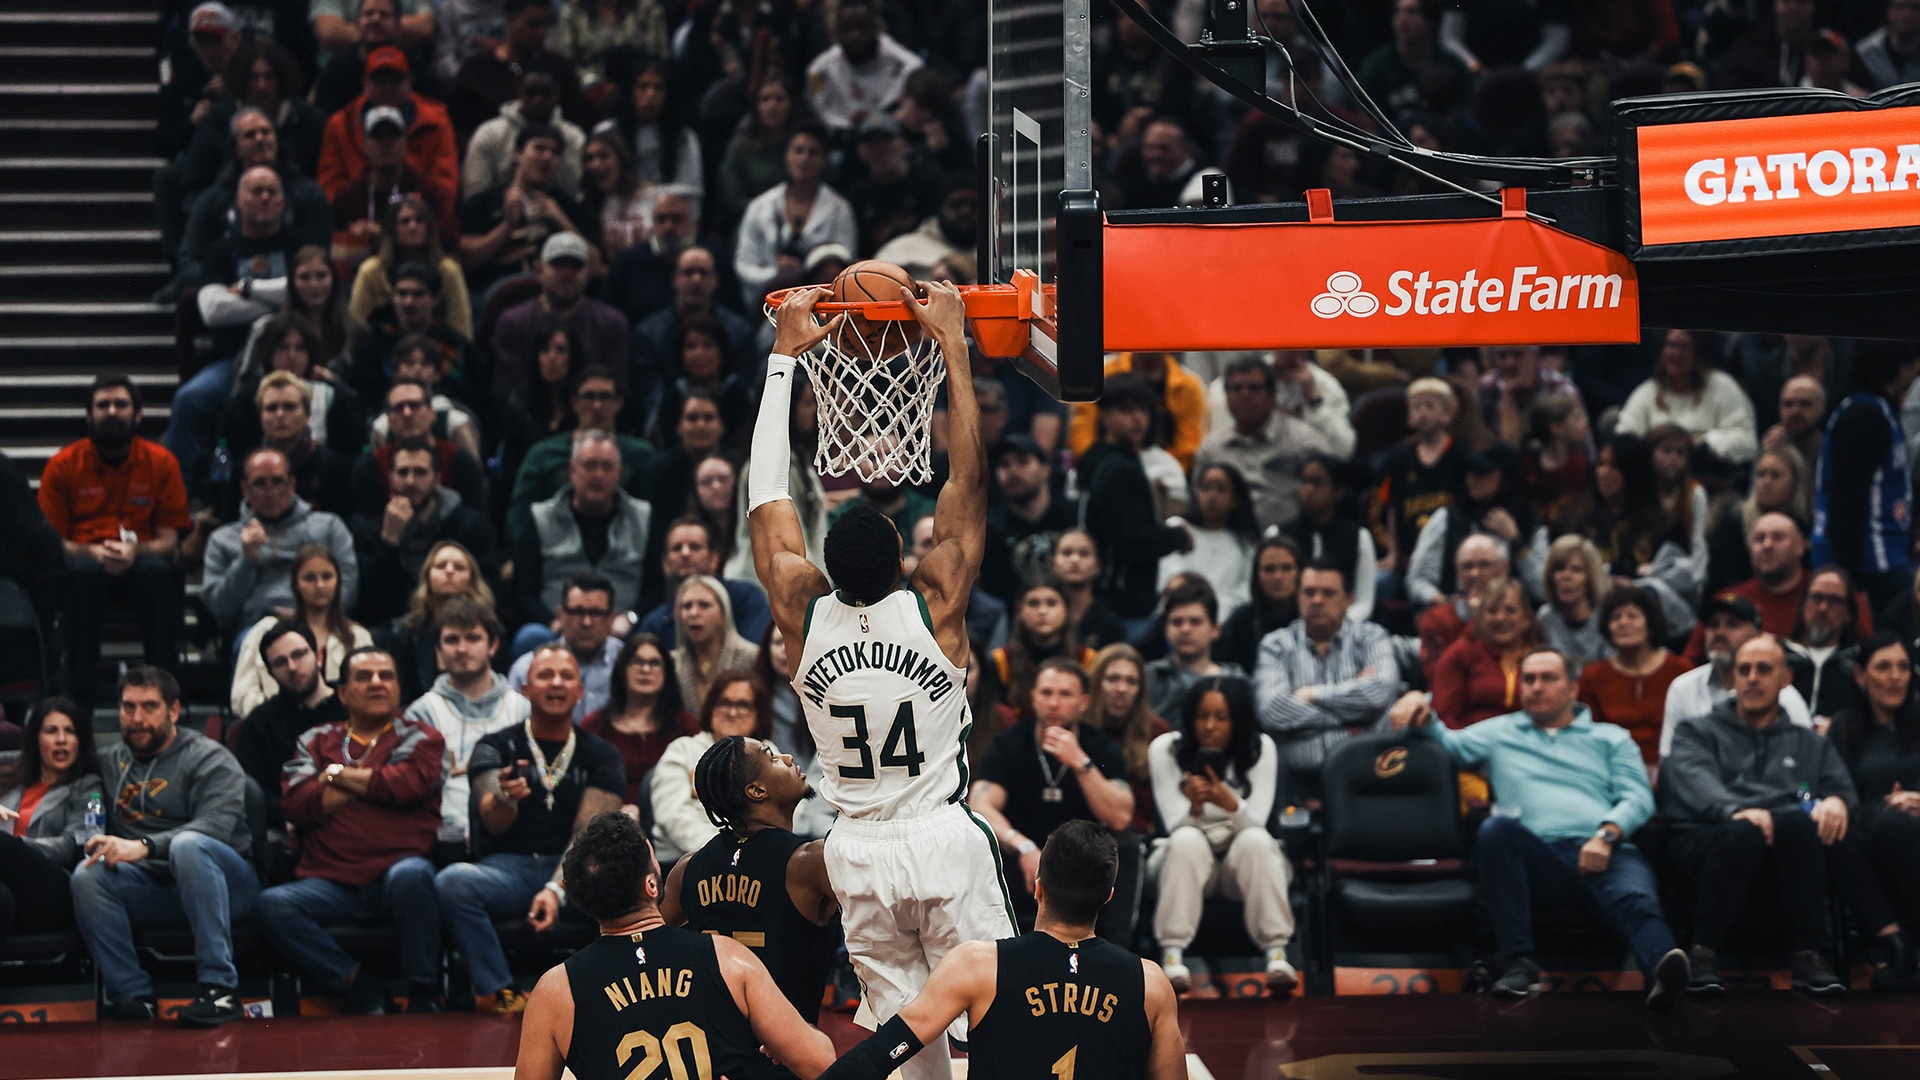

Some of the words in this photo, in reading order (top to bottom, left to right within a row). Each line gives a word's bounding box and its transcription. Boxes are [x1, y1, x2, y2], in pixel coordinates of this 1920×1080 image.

[1684, 144, 1920, 206] GATORA
[803, 640, 953, 710] ANTETOKOUNMPO
[828, 700, 926, 780] 34
[697, 873, 762, 908] OKORO
[603, 967, 694, 1013] NIANG
[1025, 982, 1119, 1023] STRUS
[615, 1020, 713, 1080] 20
